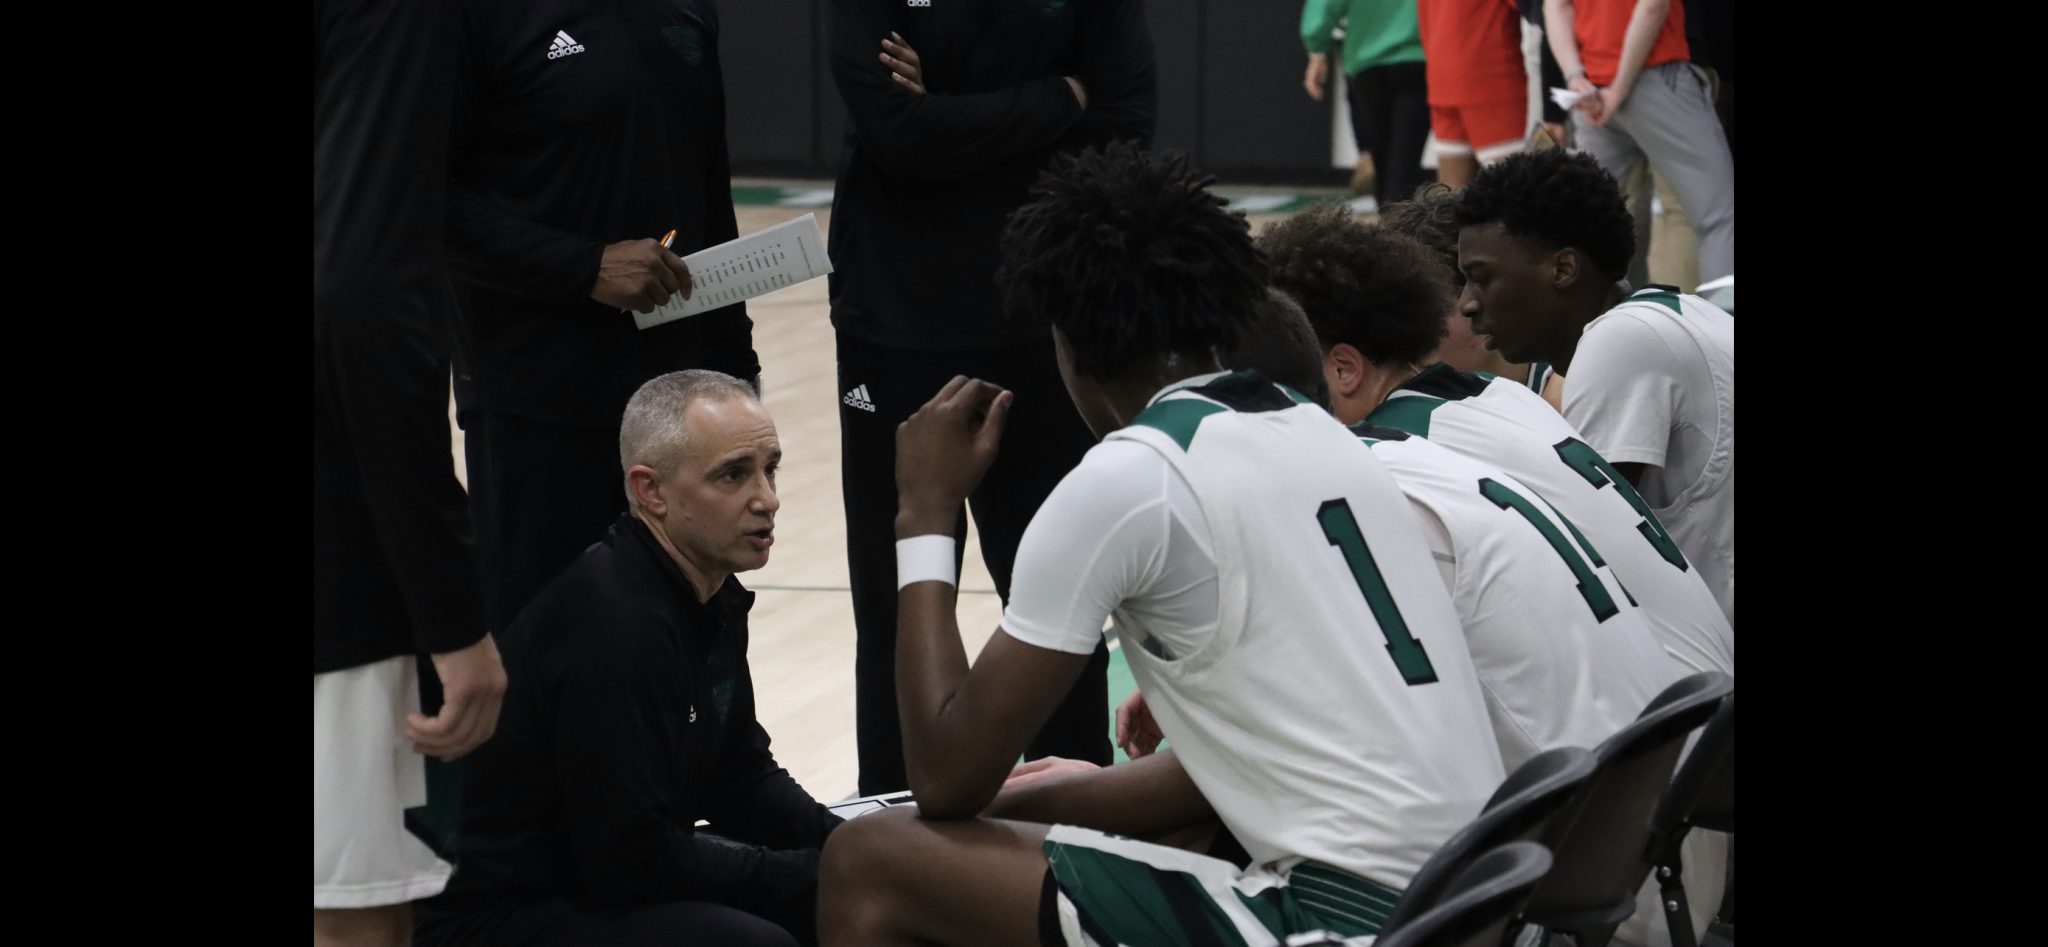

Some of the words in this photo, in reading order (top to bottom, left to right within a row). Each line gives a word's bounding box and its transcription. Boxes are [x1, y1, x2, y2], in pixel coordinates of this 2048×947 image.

[547, 44, 585, 60] adidas
[843, 395, 876, 412] adidas
[1552, 436, 1689, 573] 3
[1316, 497, 1439, 686] 1
